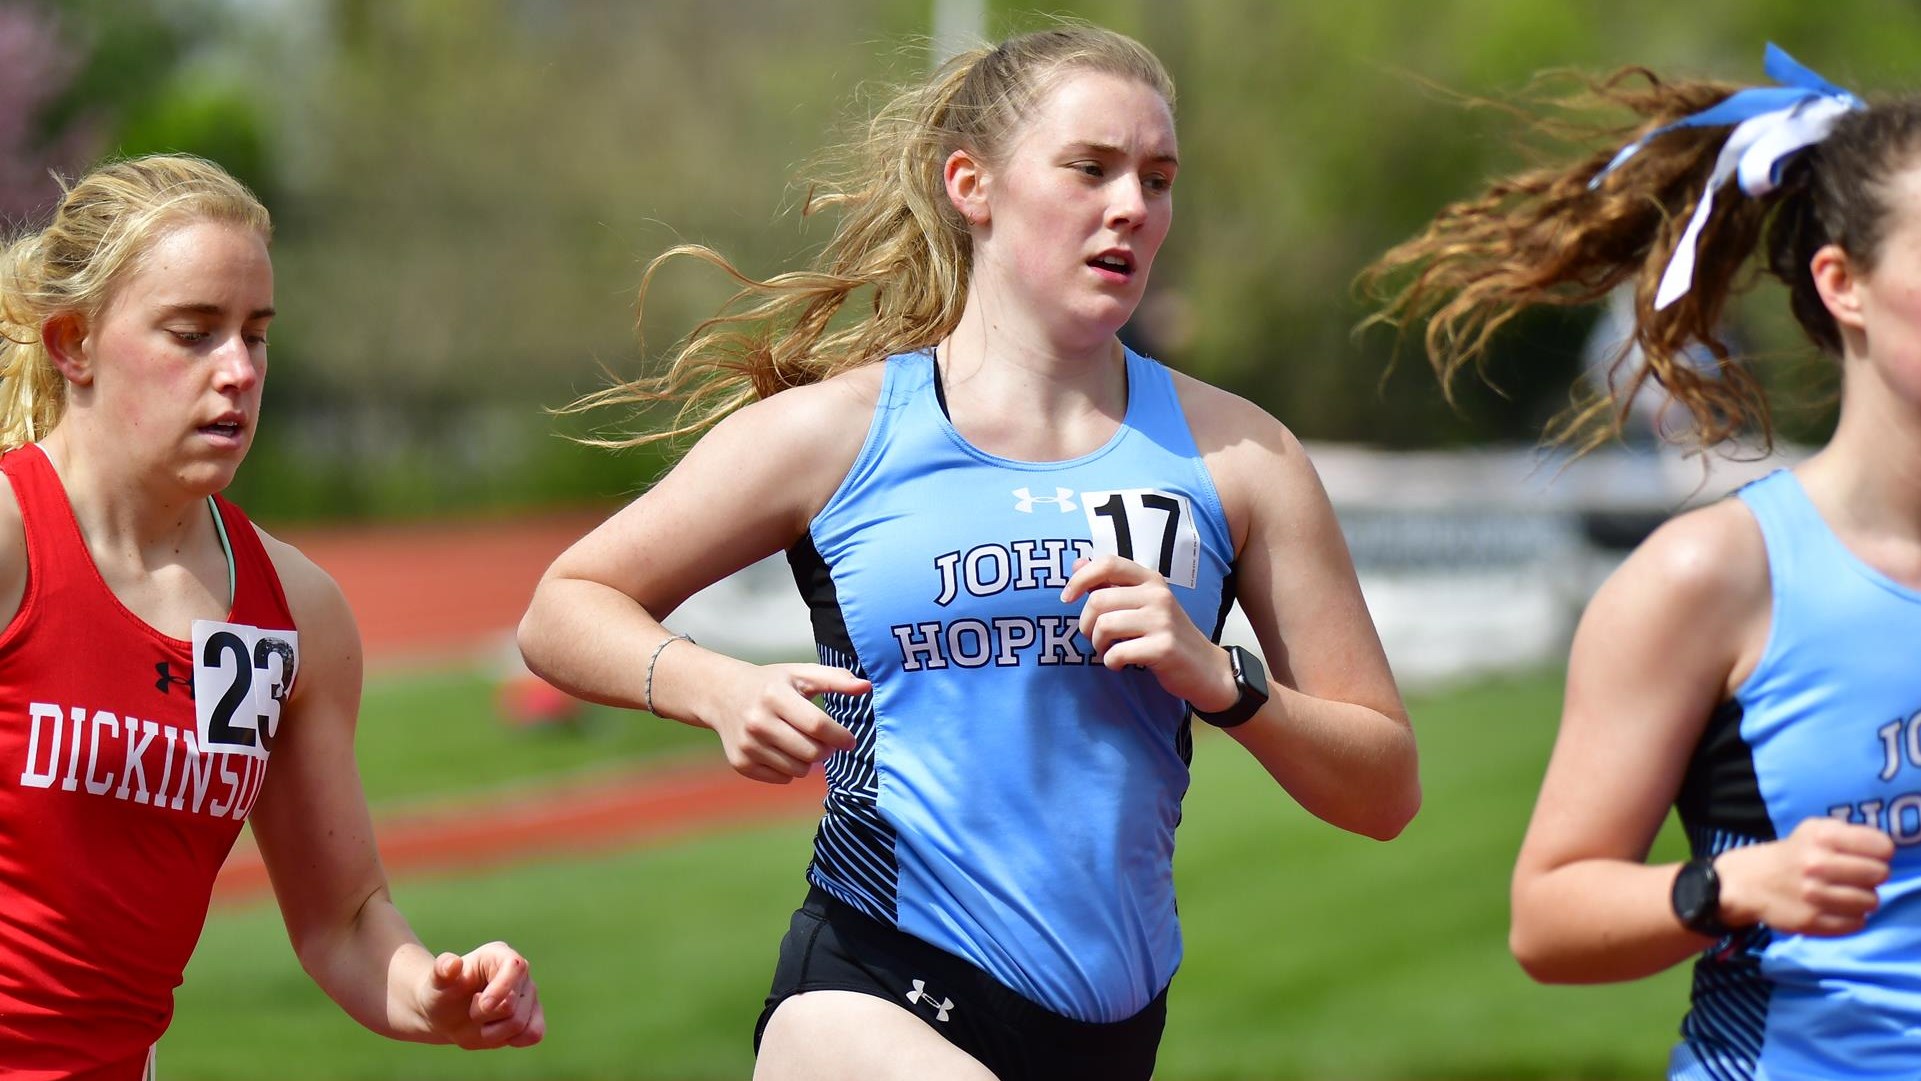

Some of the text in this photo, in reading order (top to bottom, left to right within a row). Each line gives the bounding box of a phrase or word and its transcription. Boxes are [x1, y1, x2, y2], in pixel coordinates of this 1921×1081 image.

[1094, 494, 1181, 578] 17
[203, 631, 295, 752] 23
[891, 615, 1146, 672] HOPK
[20, 702, 267, 821] DICKINSO
